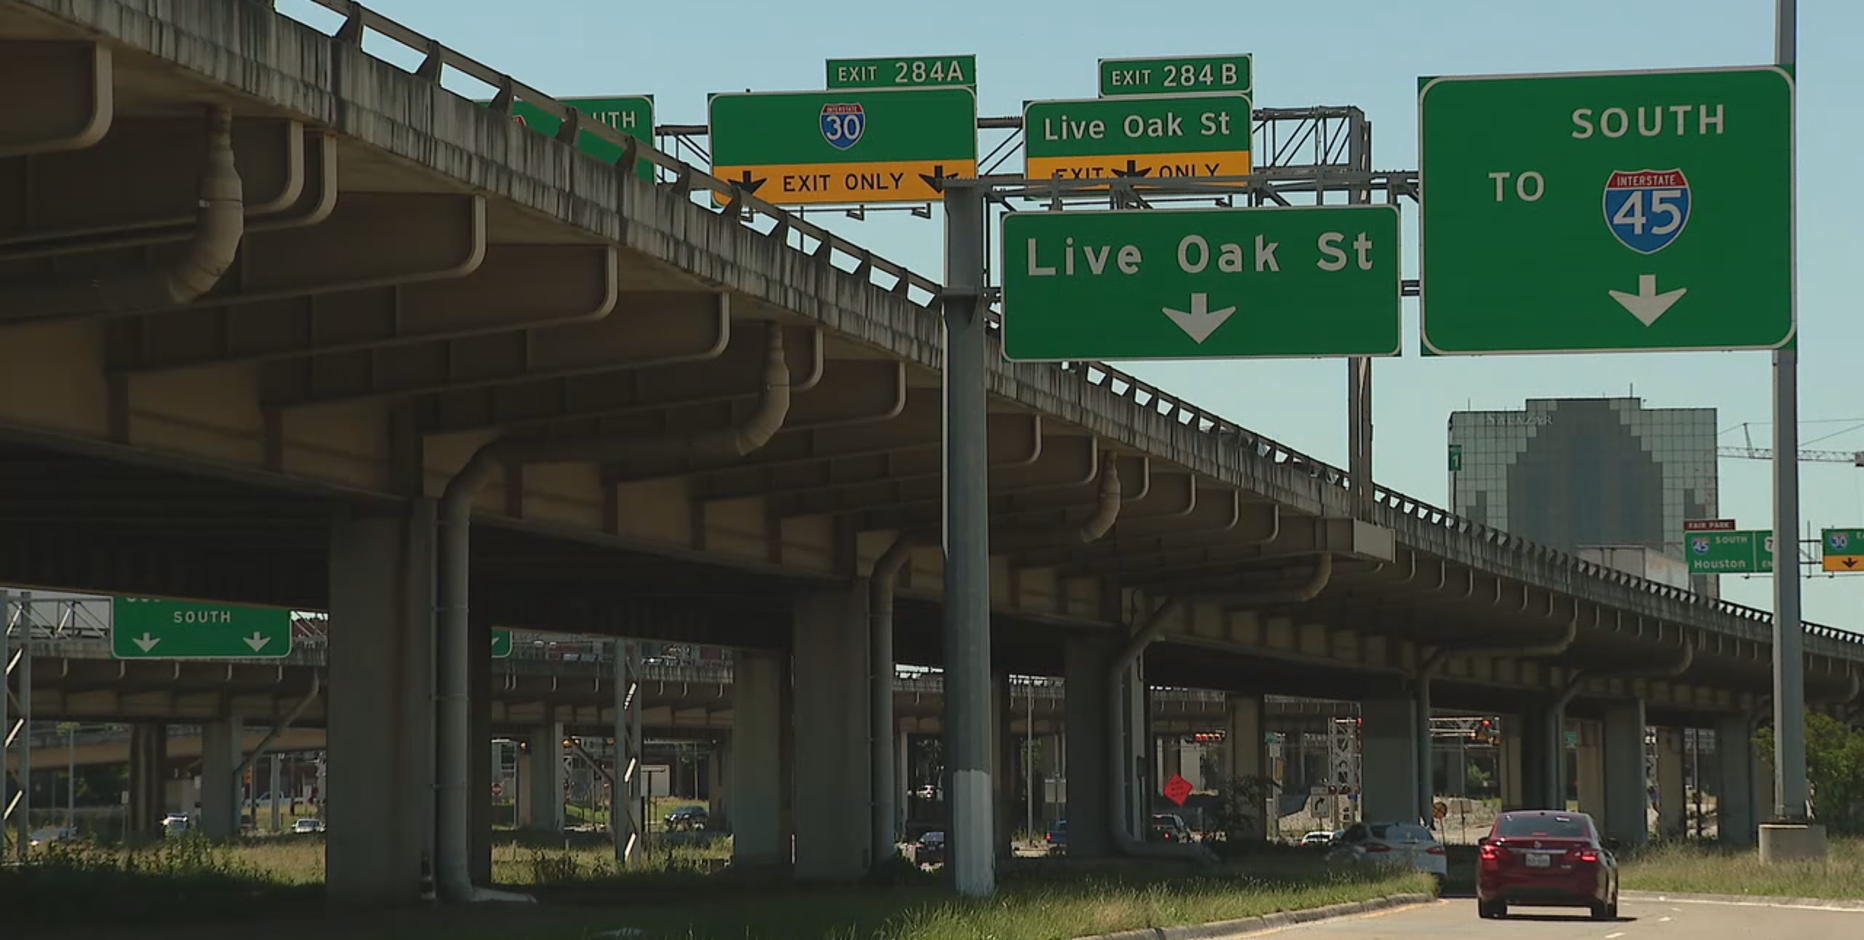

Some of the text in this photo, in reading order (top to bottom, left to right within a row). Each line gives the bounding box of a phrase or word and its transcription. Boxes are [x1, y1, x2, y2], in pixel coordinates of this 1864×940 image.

[838, 61, 964, 83] EXIT 284A
[1111, 69, 1151, 86] EXIT
[826, 114, 861, 140] 30
[1044, 110, 1230, 141] Live Oak St
[1571, 104, 1724, 139] SOUTH
[783, 172, 904, 193] EXIT ONLY
[1488, 171, 1545, 202] TO
[1617, 174, 1676, 187] INTERSTATE
[1613, 189, 1682, 235] 45
[1027, 230, 1375, 276] Live Oak St
[1709, 521, 1730, 529] PARK
[1693, 539, 1709, 552] 45
[1715, 536, 1748, 544] SOUTH
[1832, 536, 1848, 547] 30
[1694, 559, 1746, 569] Houston
[173, 610, 231, 623] SOUTH
